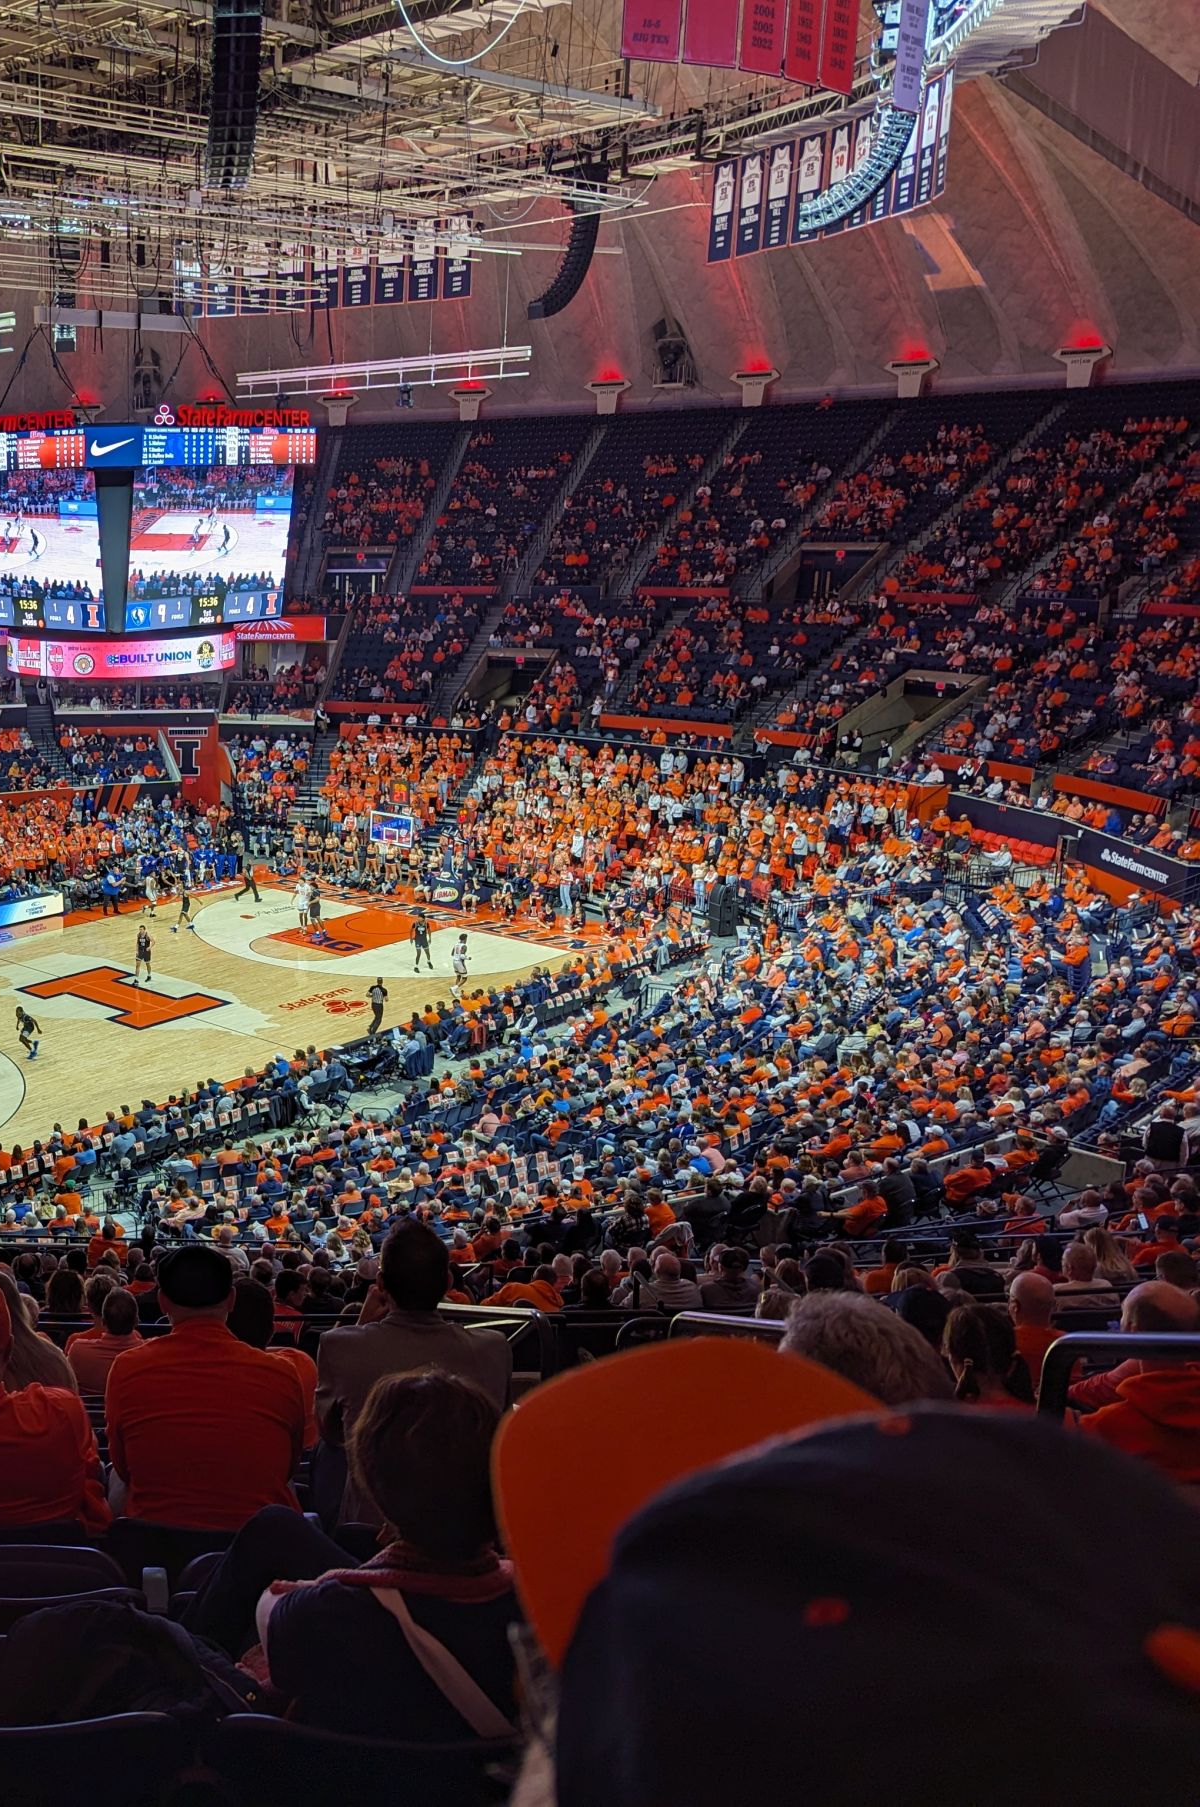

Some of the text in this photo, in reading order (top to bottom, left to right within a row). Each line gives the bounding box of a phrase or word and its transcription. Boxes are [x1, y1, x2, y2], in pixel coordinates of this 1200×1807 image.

[753, 4, 776, 19] 2004
[752, 20, 774, 34] 2005
[752, 36, 773, 50] 2022
[19, 600, 37, 610] 15:36
[199, 597, 218, 608] 15:36
[246, 597, 254, 614] 4
[25, 612, 33, 620] 1st
[67, 606, 75, 624] 4
[157, 604, 166, 623] 9
[120, 651, 192, 663] BUILT UNION
[175, 740, 201, 776] I
[1111, 852, 1169, 884] State Farm CENTER
[434, 889, 456, 898] LIBMAN
